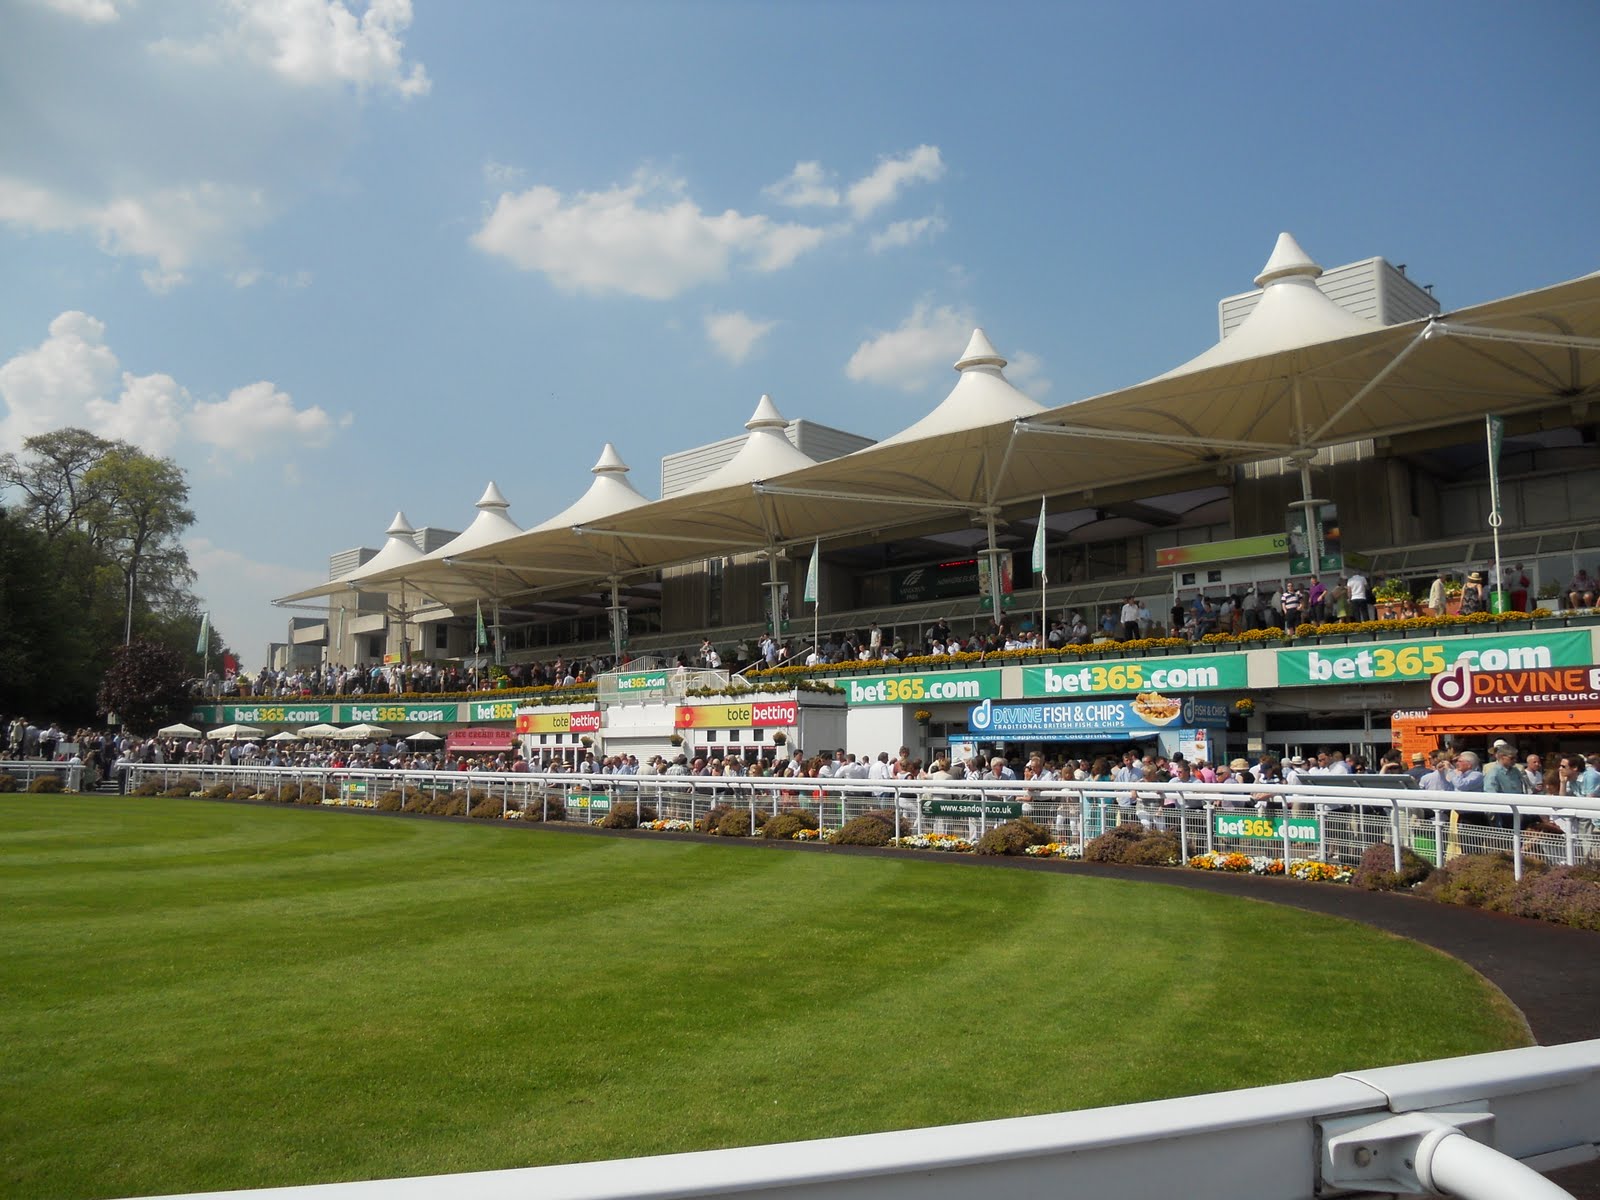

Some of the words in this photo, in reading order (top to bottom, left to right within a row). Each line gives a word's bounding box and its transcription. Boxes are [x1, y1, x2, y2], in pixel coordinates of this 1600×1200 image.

[1308, 645, 1551, 680] bet365.com
[618, 676, 665, 689] bet365.com
[1044, 665, 1218, 692] bet365.com
[851, 678, 979, 702] bet365.com
[1475, 695, 1519, 704] FILLET
[1524, 692, 1599, 703] BEEFBURG
[234, 705, 320, 722] bet365.com
[351, 706, 443, 722] bet365.com
[727, 708, 750, 721] tote
[753, 706, 795, 723] betting
[1043, 706, 1071, 722] FISH
[1073, 706, 1084, 722] &
[1086, 704, 1125, 721] CHIPS
[1195, 705, 1206, 716] FISH
[1212, 706, 1227, 717] CHIPS
[1401, 711, 1428, 719] MENU
[553, 716, 569, 728] tote
[571, 712, 600, 729] betting
[1218, 817, 1316, 840] bet365.com
